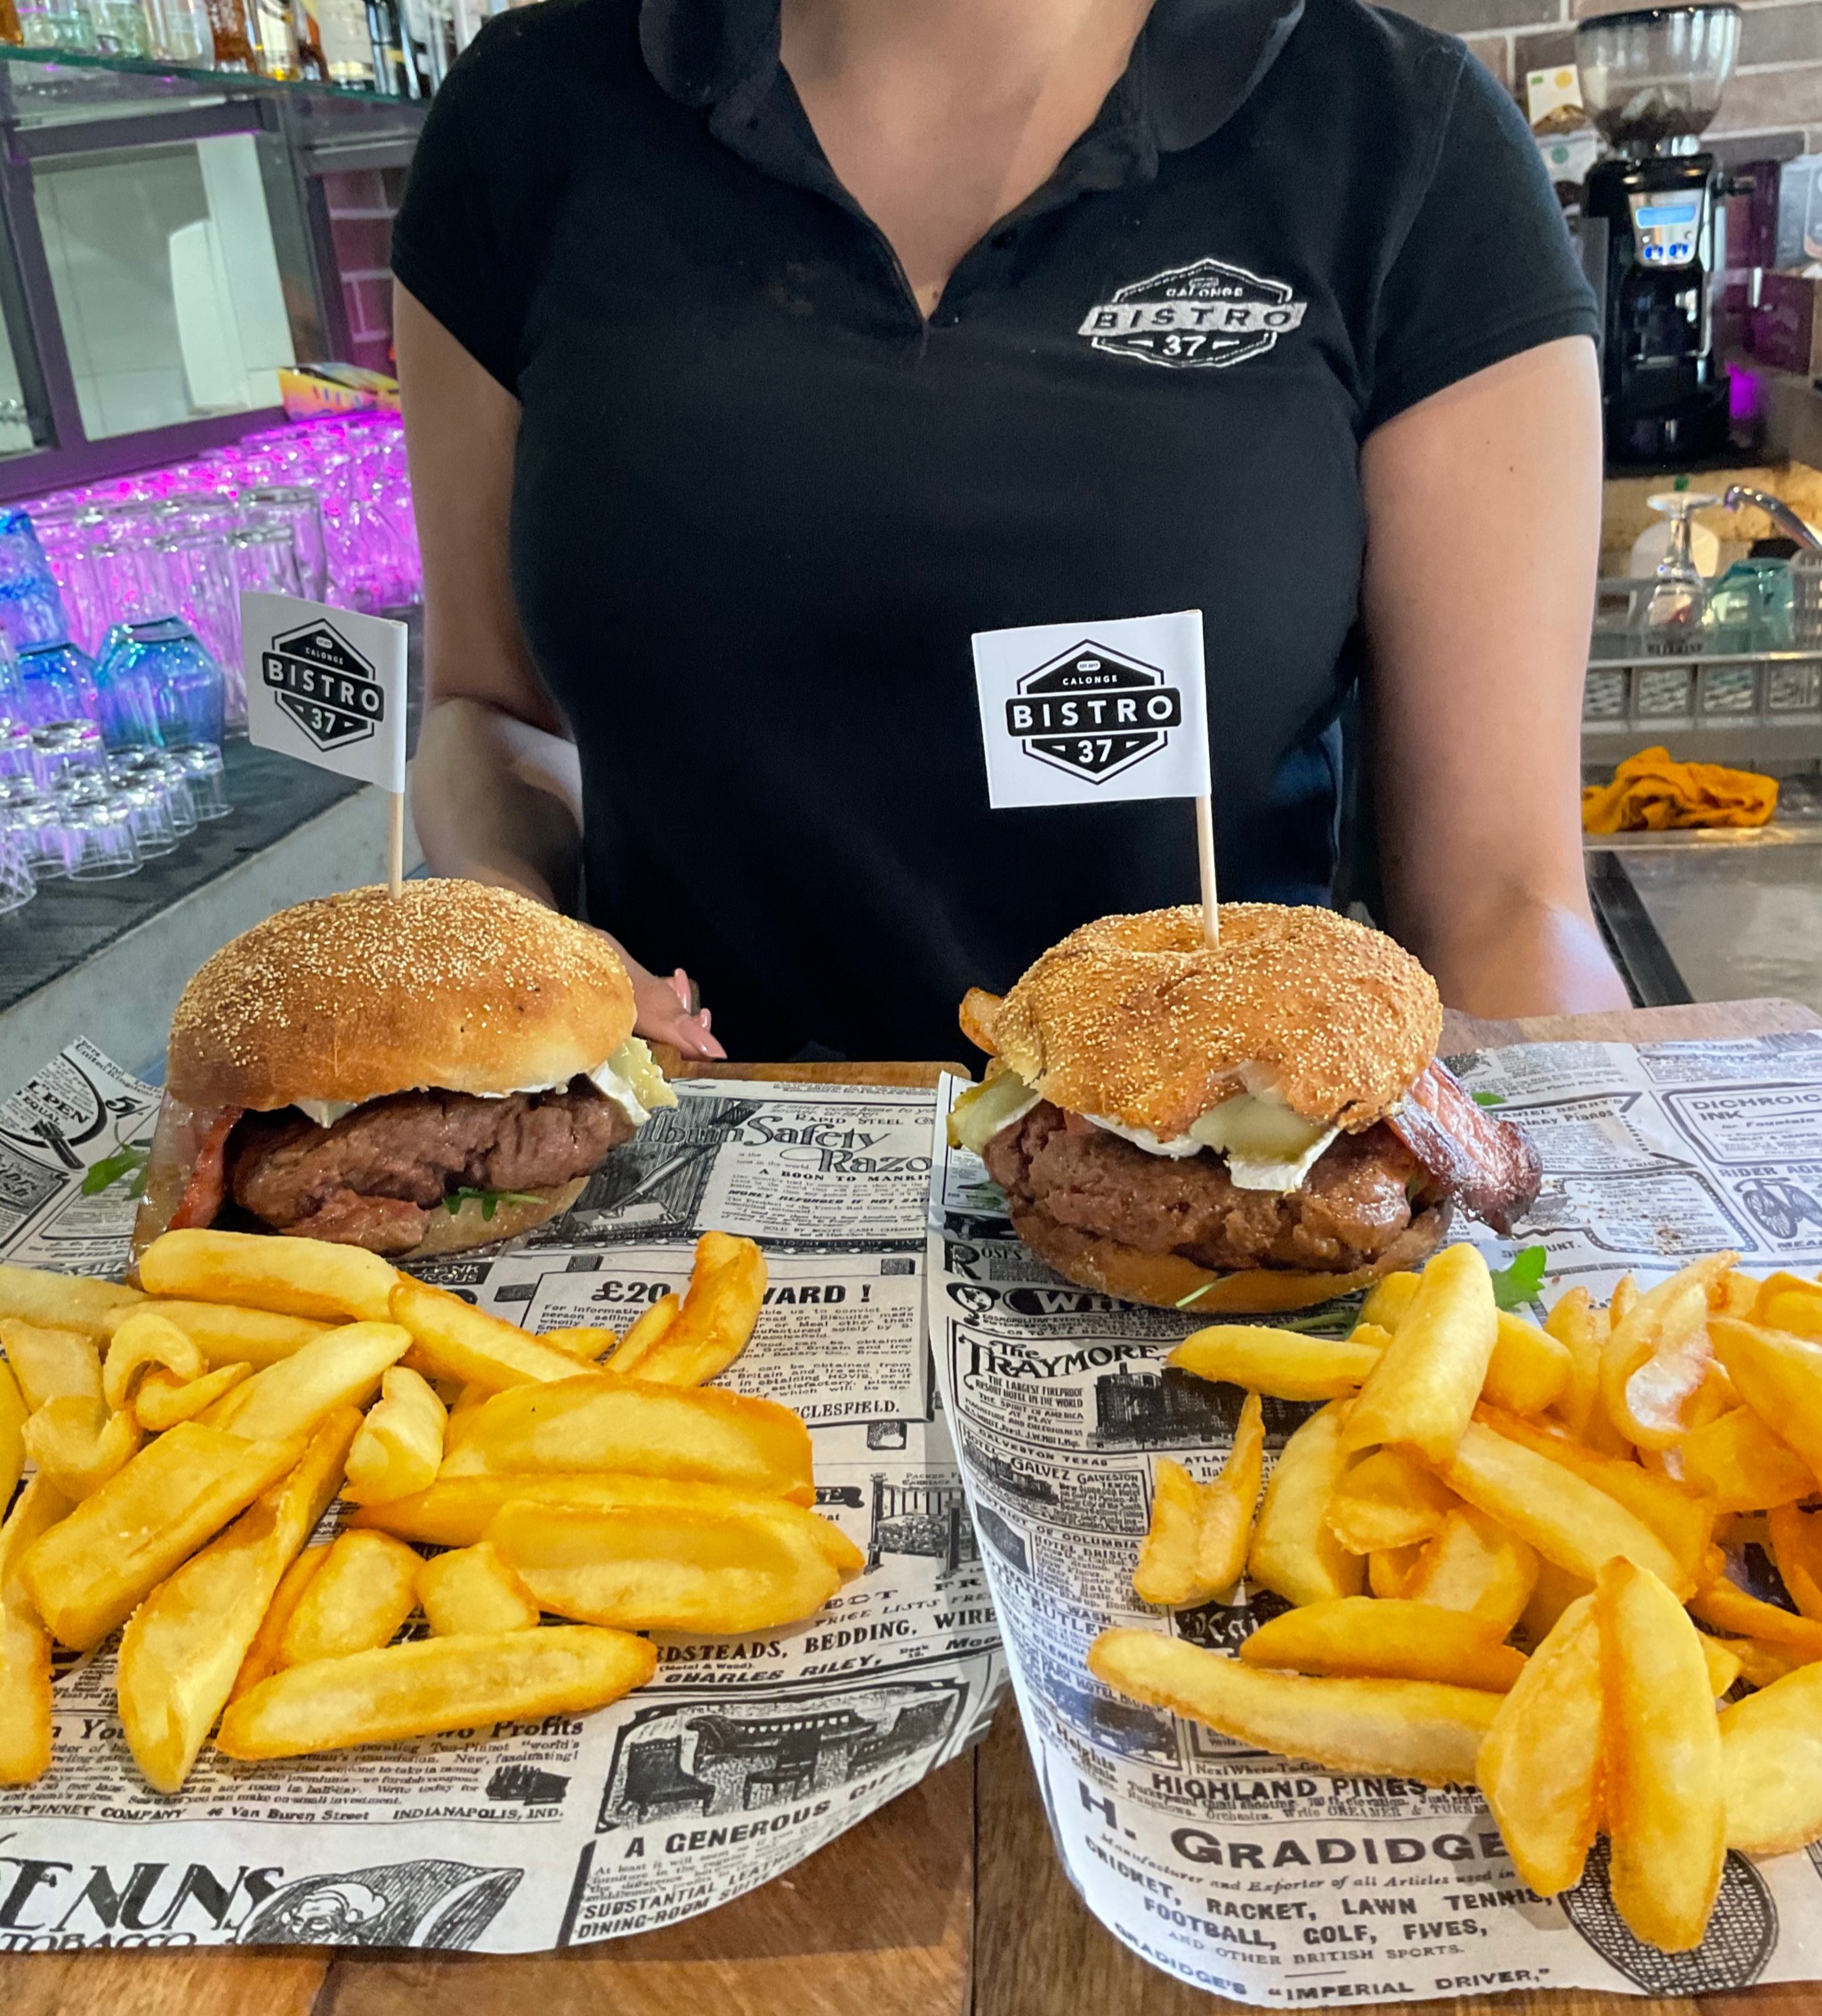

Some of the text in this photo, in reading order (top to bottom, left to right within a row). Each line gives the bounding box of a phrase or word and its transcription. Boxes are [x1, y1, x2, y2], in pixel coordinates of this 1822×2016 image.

[1092, 307, 1292, 329] BISTRO
[1162, 335, 1206, 356] 37
[268, 658, 380, 713] BISTRO
[1062, 674, 1117, 686] CALONGE
[310, 708, 336, 733] 37
[1012, 695, 1173, 729] BISTRO
[1077, 738, 1112, 763] 37
[23, 1095, 60, 1126] EQUAL
[43, 1091, 90, 1125] PEN
[1691, 1093, 1822, 1109] DICHROIC
[795, 1114, 905, 1125] RAPID STEEL
[1563, 1109, 1615, 1123] Pianos
[1698, 1110, 1745, 1121] INK
[746, 1115, 891, 1153] Safety
[781, 1170, 824, 1181] BOON
[835, 1174, 857, 1182] TO
[1718, 1166, 1778, 1178] RIDER
[729, 1190, 773, 1198] MONEY
[779, 1196, 844, 1204] REFUNDED
[591, 1280, 672, 1304] £20
[541, 1312, 584, 1320] person
[594, 1313, 635, 1323] selling
[544, 1303, 567, 1311] For
[540, 1318, 581, 1327] wholly
[958, 1335, 1168, 1383] TRAYMORE
[989, 1340, 1041, 1360] The
[738, 1371, 783, 1379] Britain
[758, 1374, 820, 1386] obtaining
[779, 1389, 818, 1397] which
[975, 1379, 1002, 1397] RESORT
[1004, 1388, 1026, 1402] HOTEL
[1055, 1398, 1084, 1408] WORLD
[988, 1375, 1084, 1398] THE LARGEST FIREPROOF
[979, 1391, 1084, 1420] THE SPIRIT AMERICA
[1008, 1409, 1053, 1425] AT PLAY
[1008, 1418, 1026, 1428] AND
[979, 1428, 1054, 1461] GALVESTON
[1061, 1455, 1109, 1466] TEXAS
[1010, 1457, 1071, 1481] GALVEZ
[1077, 1473, 1139, 1485] GALVESTON
[1034, 1534, 1076, 1554] HOTEL
[1036, 1524, 1054, 1536] OF
[1062, 1532, 1139, 1550] COLUMBIA
[814, 1609, 873, 1627] PRICE
[882, 1598, 941, 1615] LISTS
[1068, 1605, 1117, 1625] WASH.
[803, 1619, 917, 1655] BEDDING,
[933, 1607, 997, 1630] WIRE
[659, 1663, 698, 1672] (Metal
[665, 1653, 883, 1683] CHARLES RILEY,
[490, 1715, 584, 1738] Profits
[455, 1754, 489, 1765] New,
[1197, 1763, 1229, 1776] Next
[248, 1784, 479, 1794] room today for
[1152, 1772, 1318, 1801] HIGHLAND
[1331, 1777, 1427, 1797] PINES
[237, 1794, 270, 1802] make
[101, 1807, 187, 1820] COMPANY
[206, 1807, 224, 1817] 46
[231, 1806, 260, 1818] Van
[267, 1808, 316, 1821] Buren
[321, 1810, 370, 1820] Street
[392, 1805, 522, 1821] INDIANAPOLIS,
[527, 1808, 564, 1818] IND.
[1076, 1778, 1510, 1869] H. GRADIDGE
[1205, 1811, 1272, 1821] Orchestra.
[625, 1836, 645, 1859] A
[665, 1799, 833, 1854] GENEROUS
[618, 1856, 692, 1873] least will
[1100, 1833, 1516, 1895] Manufacturer and Exporter of all Articles used in
[593, 1872, 649, 1884] furniture
[1084, 1835, 1182, 1907] CRICKET,
[1205, 1897, 1317, 1921] RACKET,
[1341, 1897, 1417, 1916] LAWN
[584, 1882, 717, 1920] SUBSTANTIAL
[577, 1896, 710, 1939] DINING-ROOM
[1143, 1895, 1487, 1951] FOOTBALL, GOLF, FIVES,
[1168, 1931, 1464, 1965] AND OTHER BRITISH SPORTS.
[1115, 1922, 1247, 1996] GRADIDGE'S
